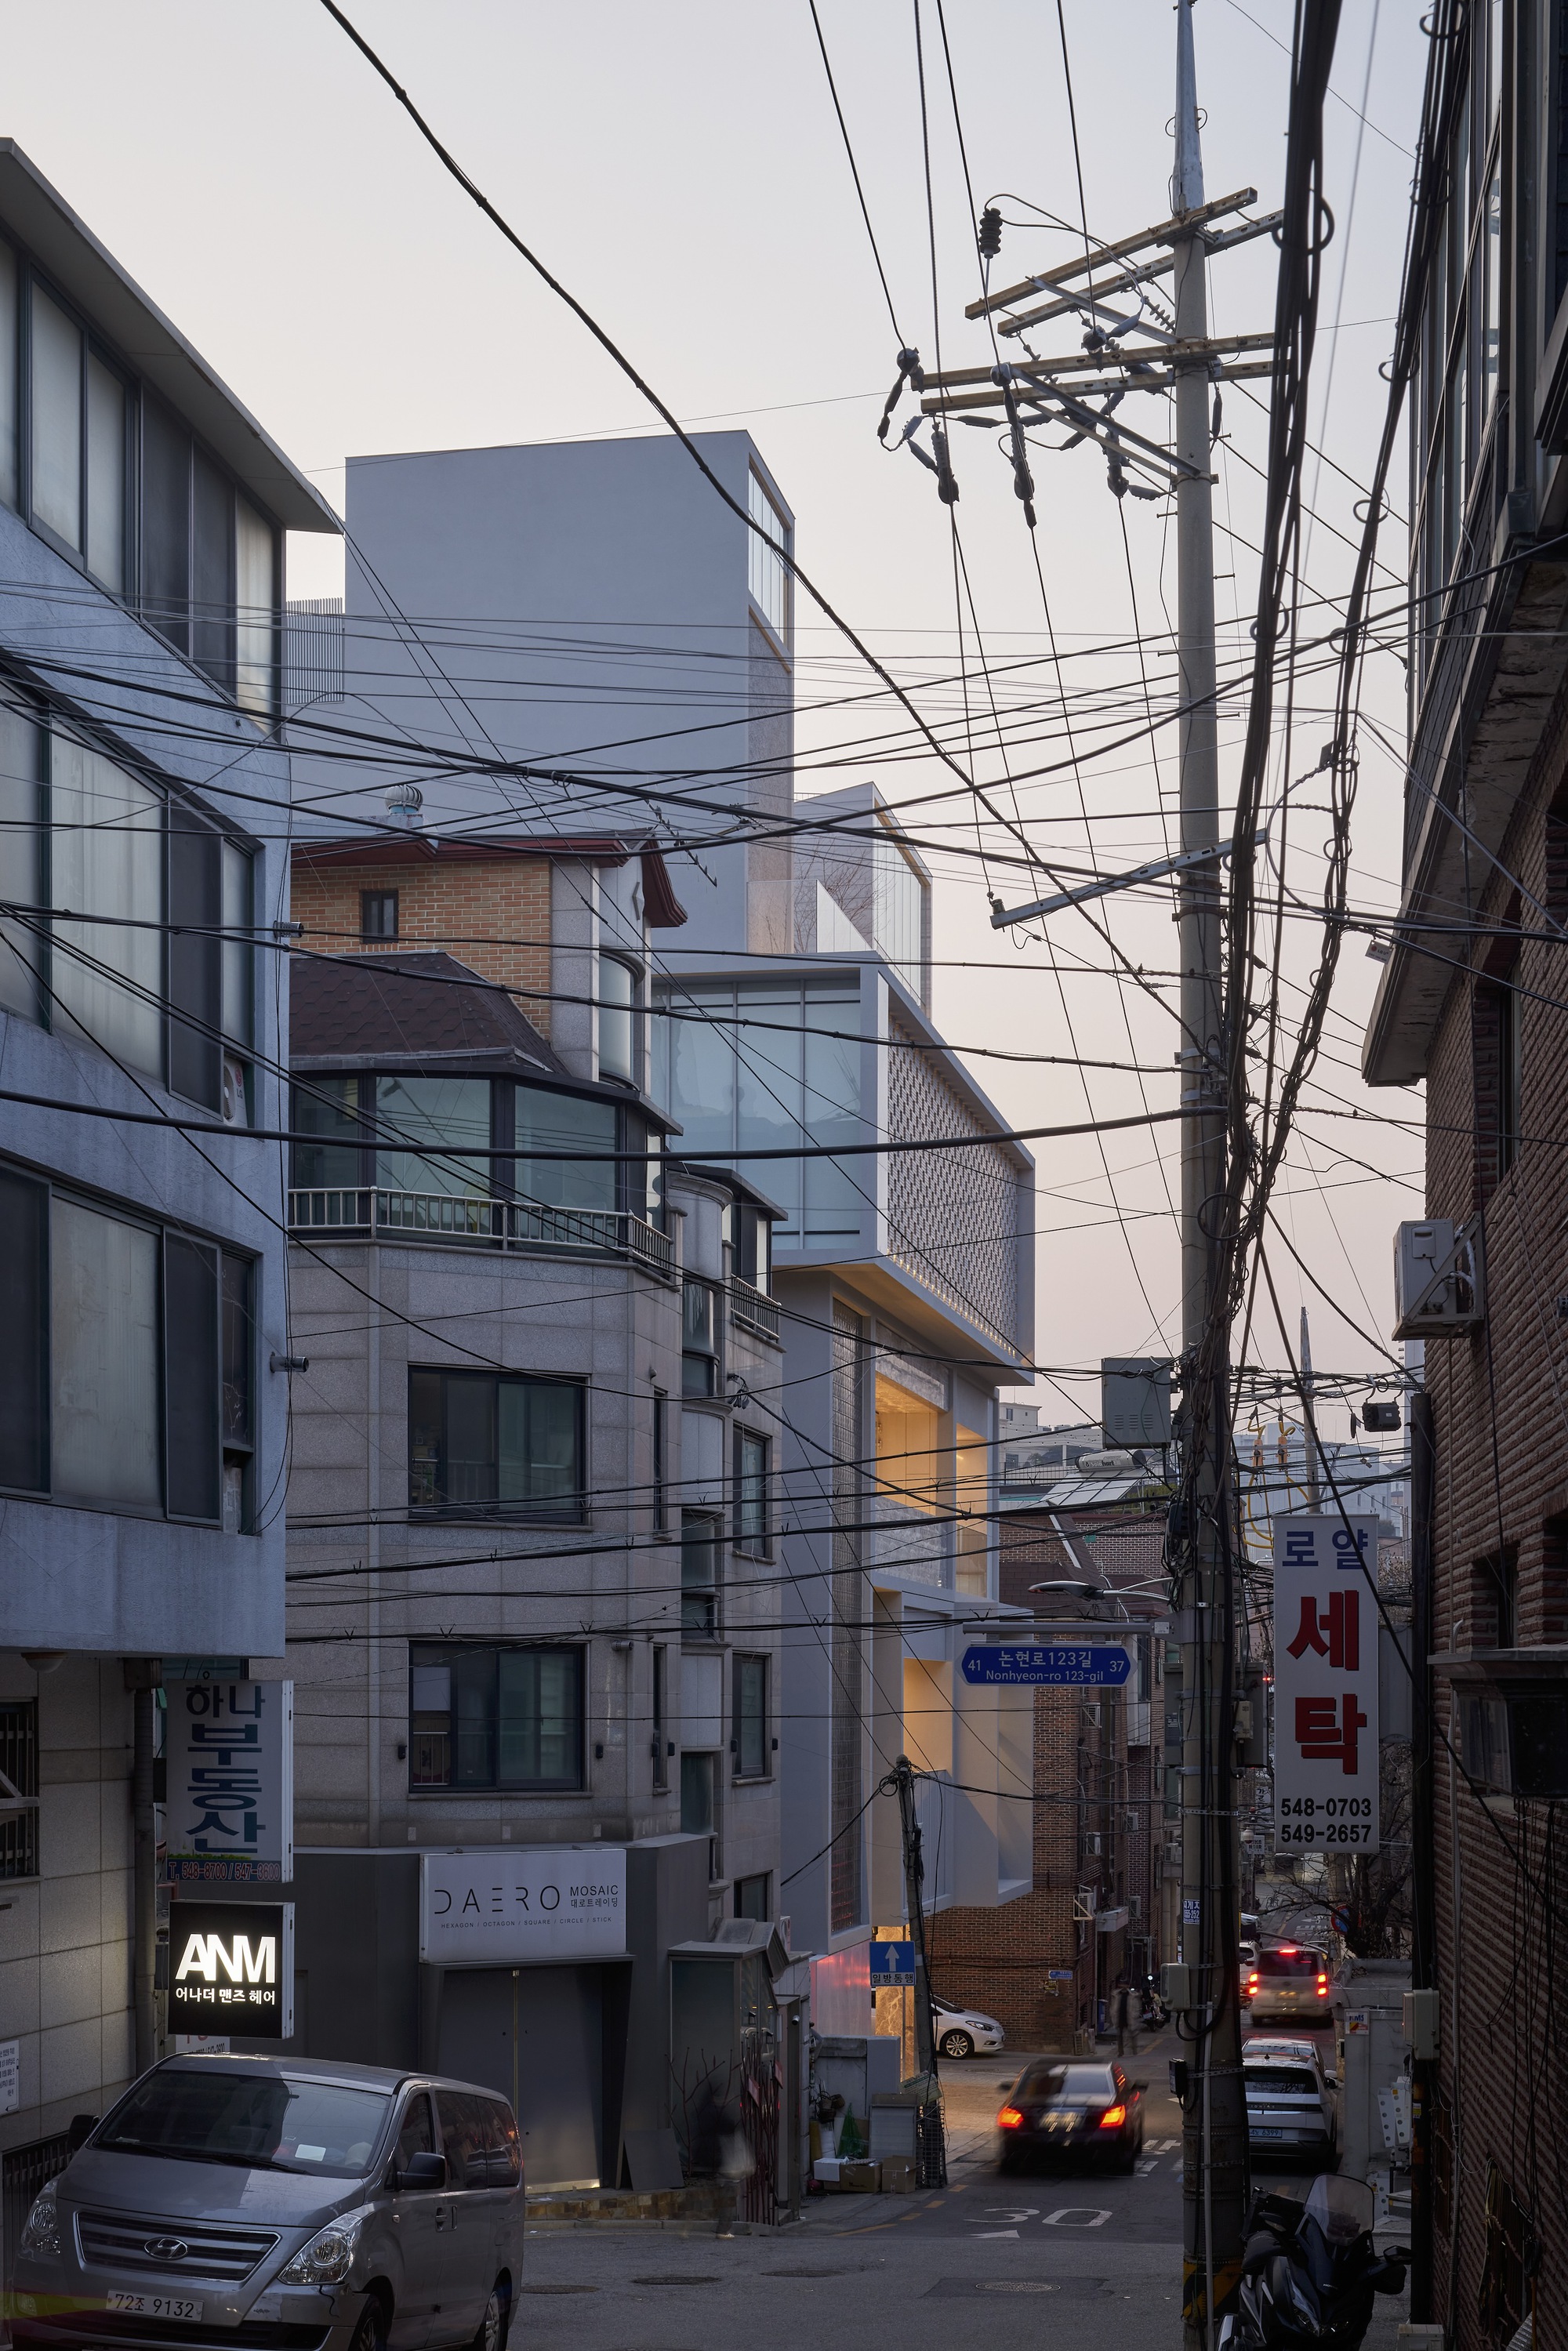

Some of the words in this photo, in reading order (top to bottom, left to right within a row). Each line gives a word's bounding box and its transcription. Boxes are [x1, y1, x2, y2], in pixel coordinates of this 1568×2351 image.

[1282, 1529, 1368, 1569] 로얄
[967, 1659, 982, 1672] 41
[998, 1650, 1092, 1668] 논현로123길
[1109, 1660, 1124, 1673] 37
[985, 1670, 1062, 1682] Nonhyeon-ro
[1065, 1670, 1104, 1683] 123-gil
[1286, 1590, 1367, 1775] 세탁
[186, 1685, 266, 1718] 하나
[185, 1724, 267, 1853] 부동산
[1280, 1798, 1372, 1817] 548-0703
[1280, 1824, 1372, 1843] 549-2657
[181, 1863, 227, 1880] 548-8700
[234, 1863, 281, 1881] 547-3600
[434, 1885, 560, 1914] DAERO
[570, 1885, 619, 1896] MOSAIC
[571, 1897, 618, 1908] 대로트레이딩
[175, 1934, 276, 1983] ANM
[873, 1973, 913, 1984] 일방통행
[176, 1987, 216, 2003] 어나더
[219, 1989, 246, 2004] 맨즈
[249, 1990, 275, 2005] 헤어
[964, 2208, 1113, 2227] 30
[115, 2294, 144, 2311] 72조
[153, 2298, 194, 2318] 9132
